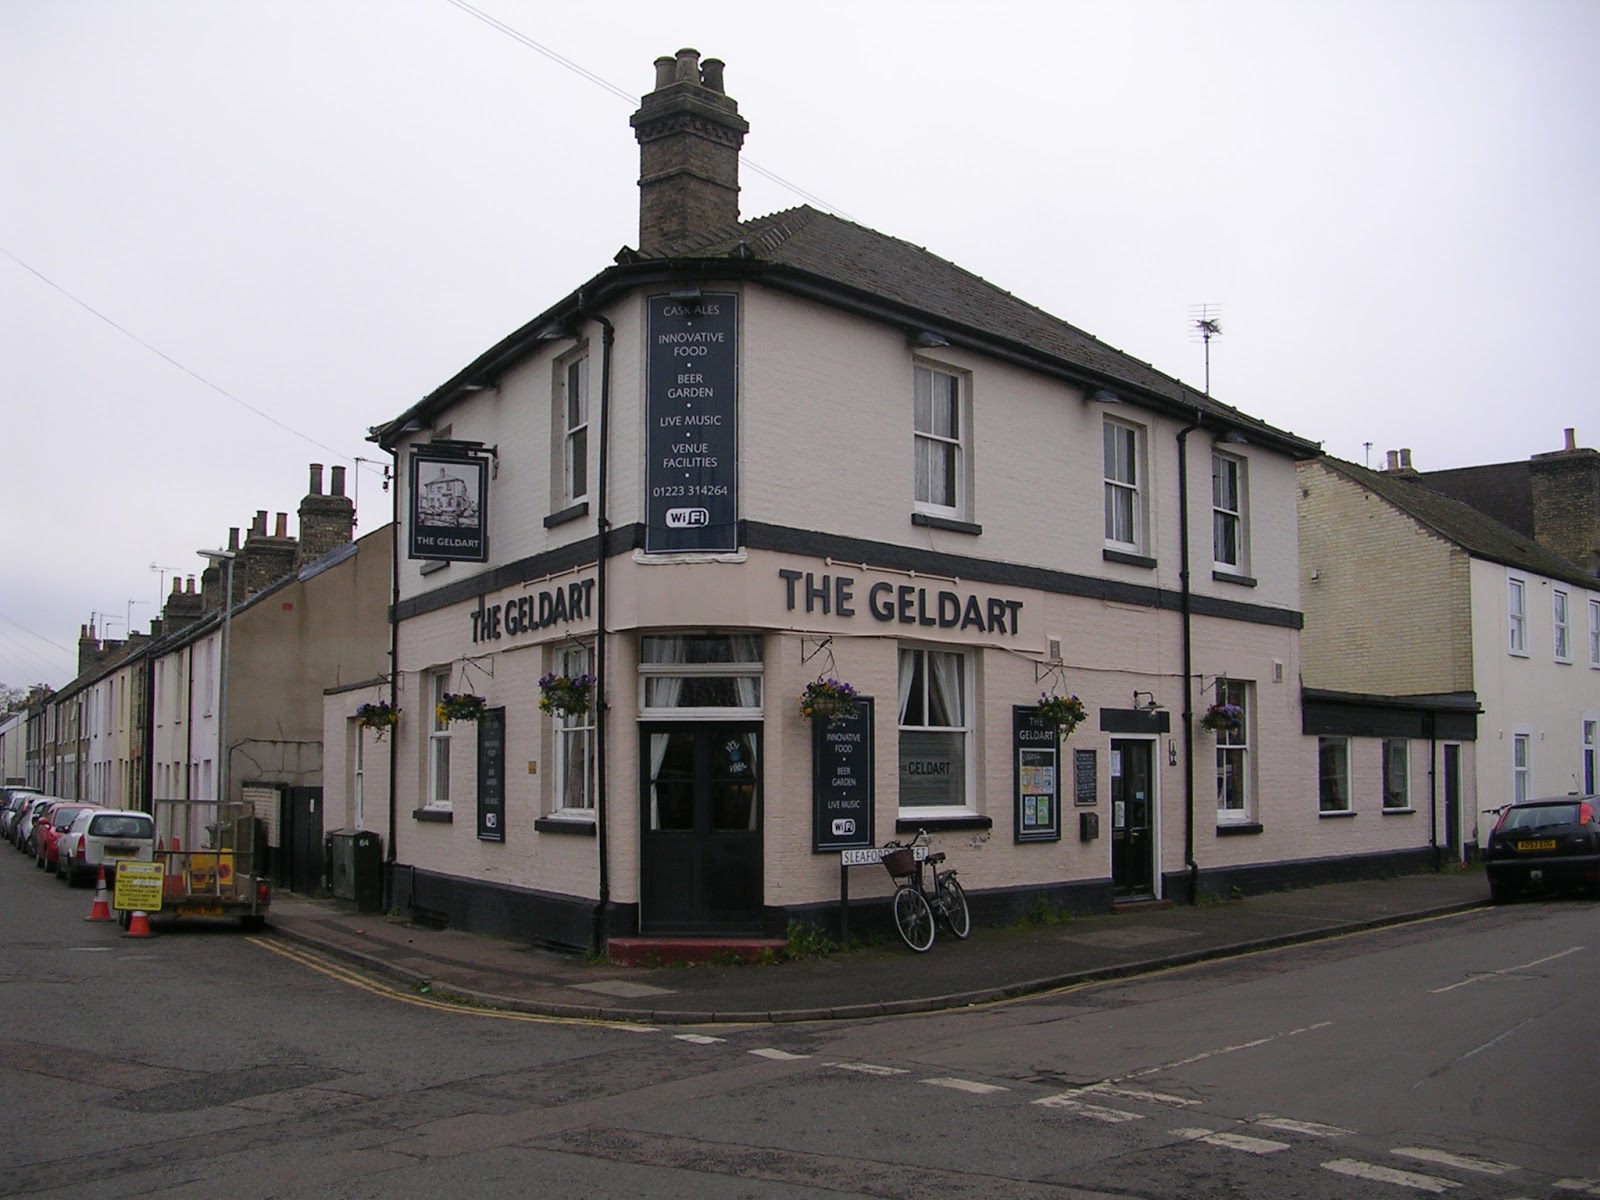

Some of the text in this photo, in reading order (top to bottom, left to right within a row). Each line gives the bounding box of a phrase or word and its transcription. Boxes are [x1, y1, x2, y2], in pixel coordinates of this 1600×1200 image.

[663, 305, 720, 316] CASK ALES
[658, 332, 724, 344] INNOVATIVE
[674, 346, 708, 356] FOOD
[677, 374, 703, 384] BEER
[667, 387, 714, 399] GARDEN
[660, 415, 722, 427] LIVE MUSIC
[671, 443, 709, 454] VENUE
[663, 457, 718, 468] FACILITIES
[653, 485, 728, 497] 01223 314264
[668, 510, 707, 525] WiFi
[416, 536, 480, 547] THE GELDART
[778, 568, 1024, 635] THE GELDART
[470, 577, 596, 644] THE GELDART
[1029, 716, 1044, 726] THE
[826, 733, 861, 742] INNOVATIVE
[1020, 730, 1054, 740] GELDART
[834, 744, 853, 753] FOOD
[837, 767, 851, 776] BEER
[832, 778, 856, 787] GARDEN
[827, 800, 860, 809] LIVE MUSIC
